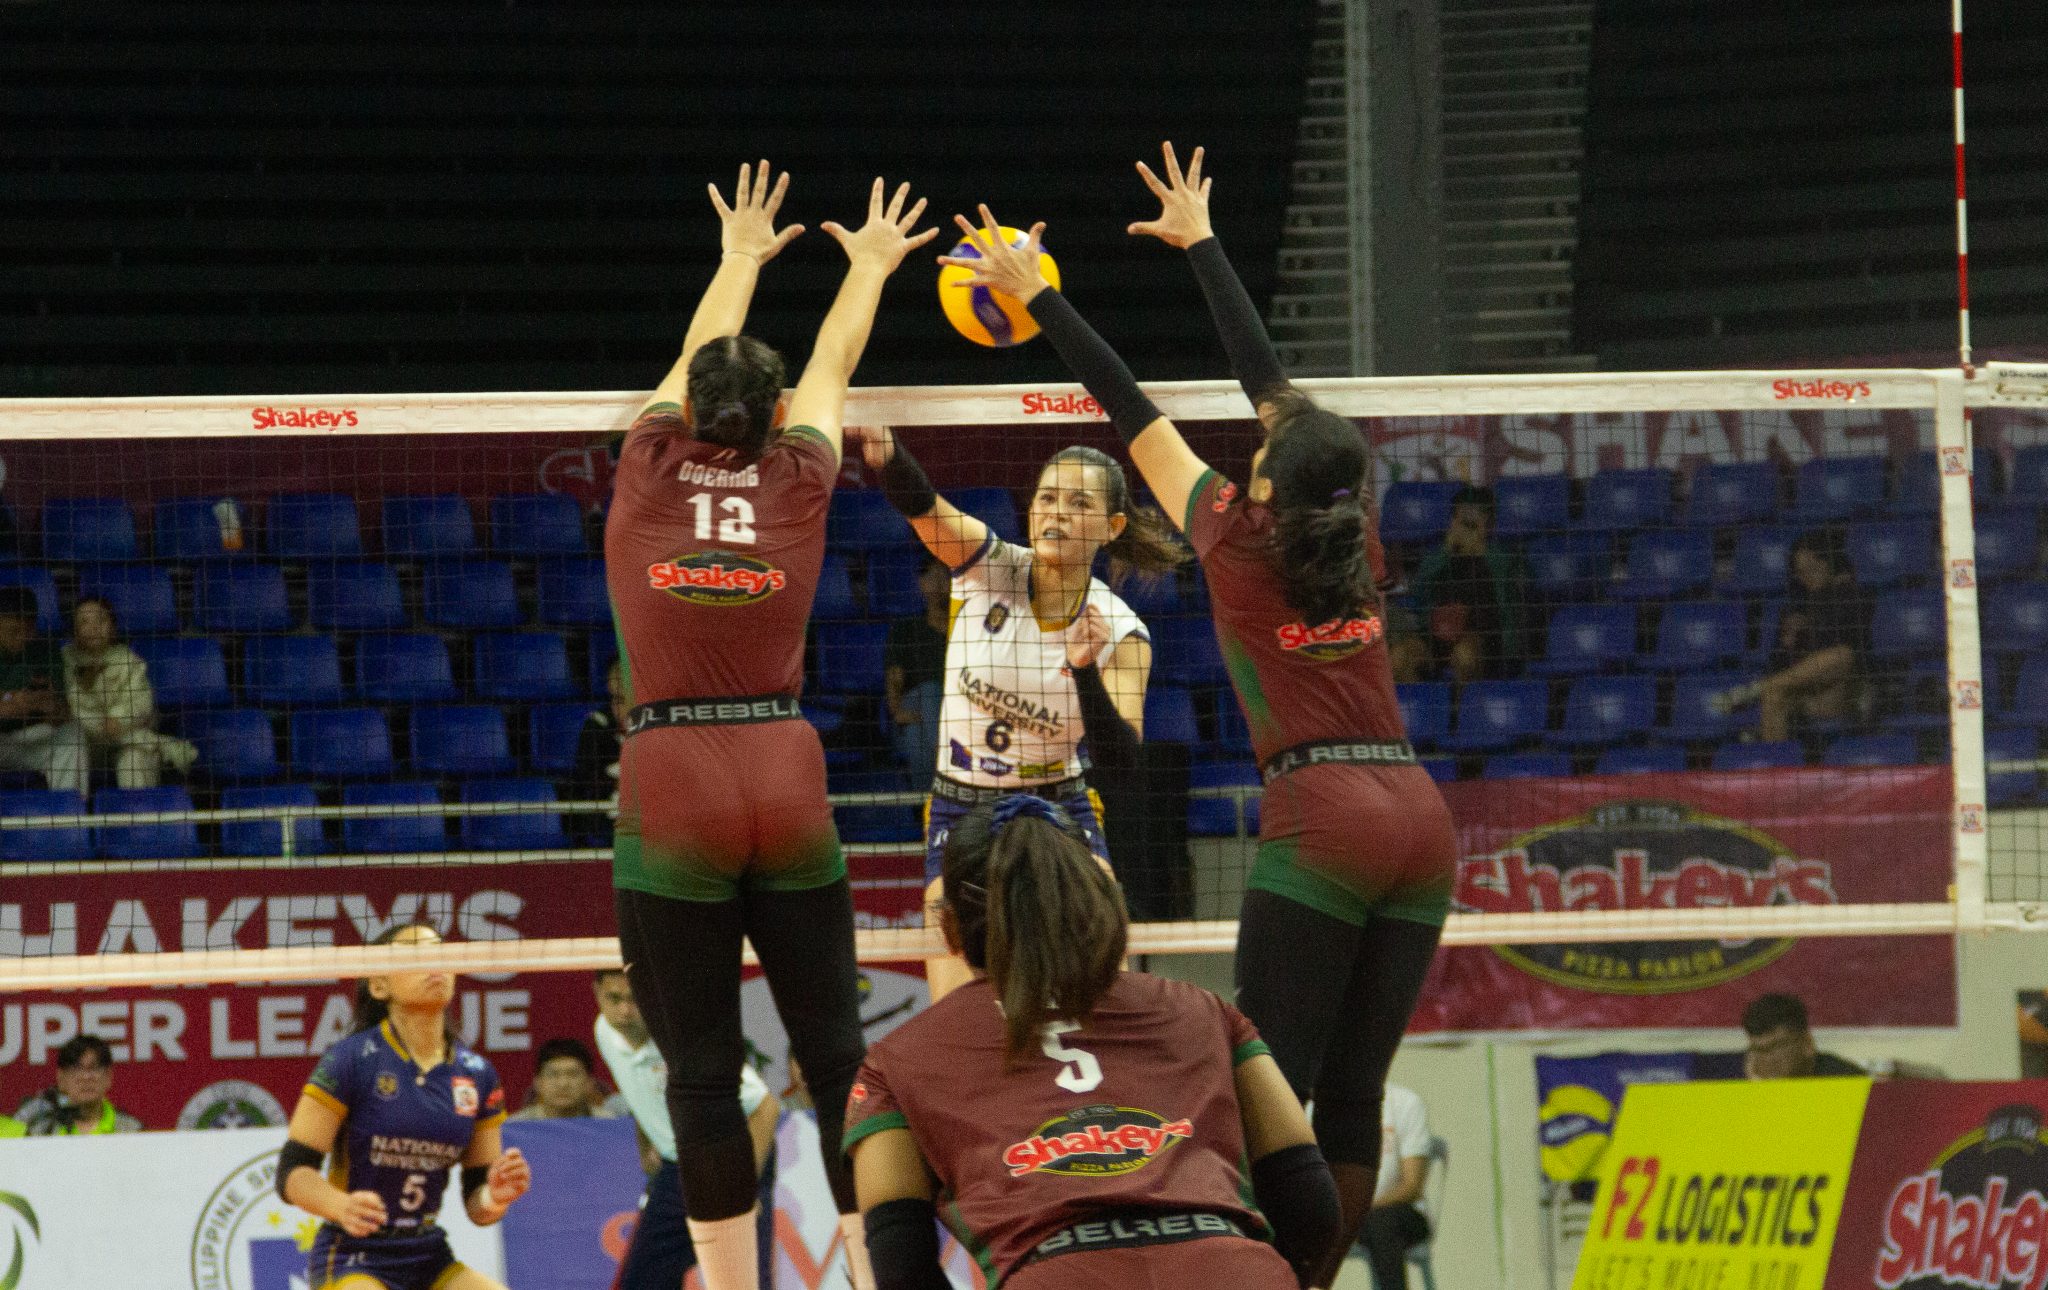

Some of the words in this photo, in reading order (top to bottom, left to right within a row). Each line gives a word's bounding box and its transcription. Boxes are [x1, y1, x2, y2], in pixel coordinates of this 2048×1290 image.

[1772, 378, 1871, 401] Shakey's
[251, 407, 359, 431] Shakey's
[686, 492, 757, 545] 12
[648, 562, 786, 594] Shakey's
[958, 666, 1065, 729] NATIONAL
[985, 720, 1014, 753] 6
[1041, 1020, 1104, 1094] 5
[400, 1173, 428, 1212] 5
[1601, 1156, 1661, 1241] F2
[1655, 1173, 1830, 1247] LOGISTICS
